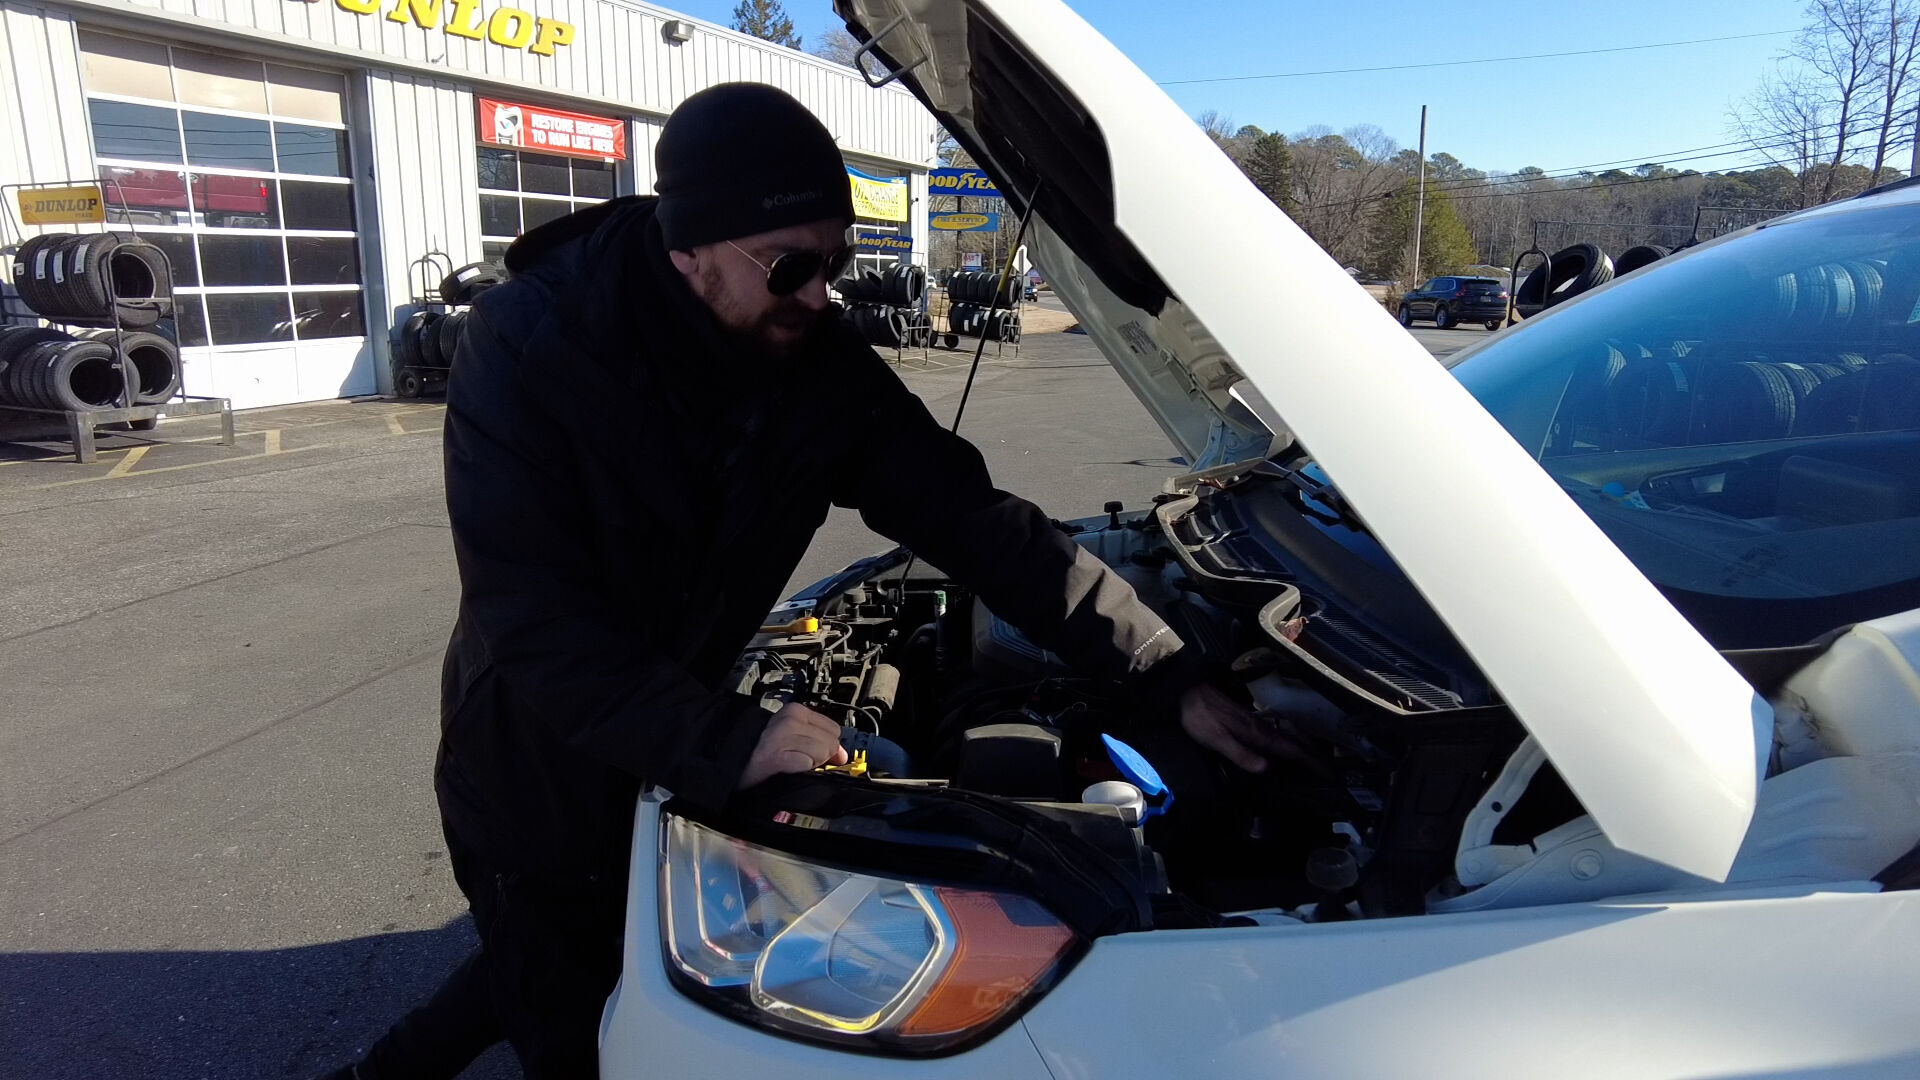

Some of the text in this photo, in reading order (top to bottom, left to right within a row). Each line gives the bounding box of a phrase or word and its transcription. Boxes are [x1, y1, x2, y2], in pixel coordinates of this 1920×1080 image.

[302, 0, 576, 56] NLOP
[531, 113, 614, 139] RESTORE ENGINES
[532, 129, 547, 145] TO
[548, 131, 570, 148] RUN
[571, 134, 592, 150] LIKE
[928, 172, 997, 191] OODYEA
[869, 184, 898, 205] CHANGE
[35, 198, 98, 213] DUNLOP
[856, 237, 911, 249] GOODYEAR
